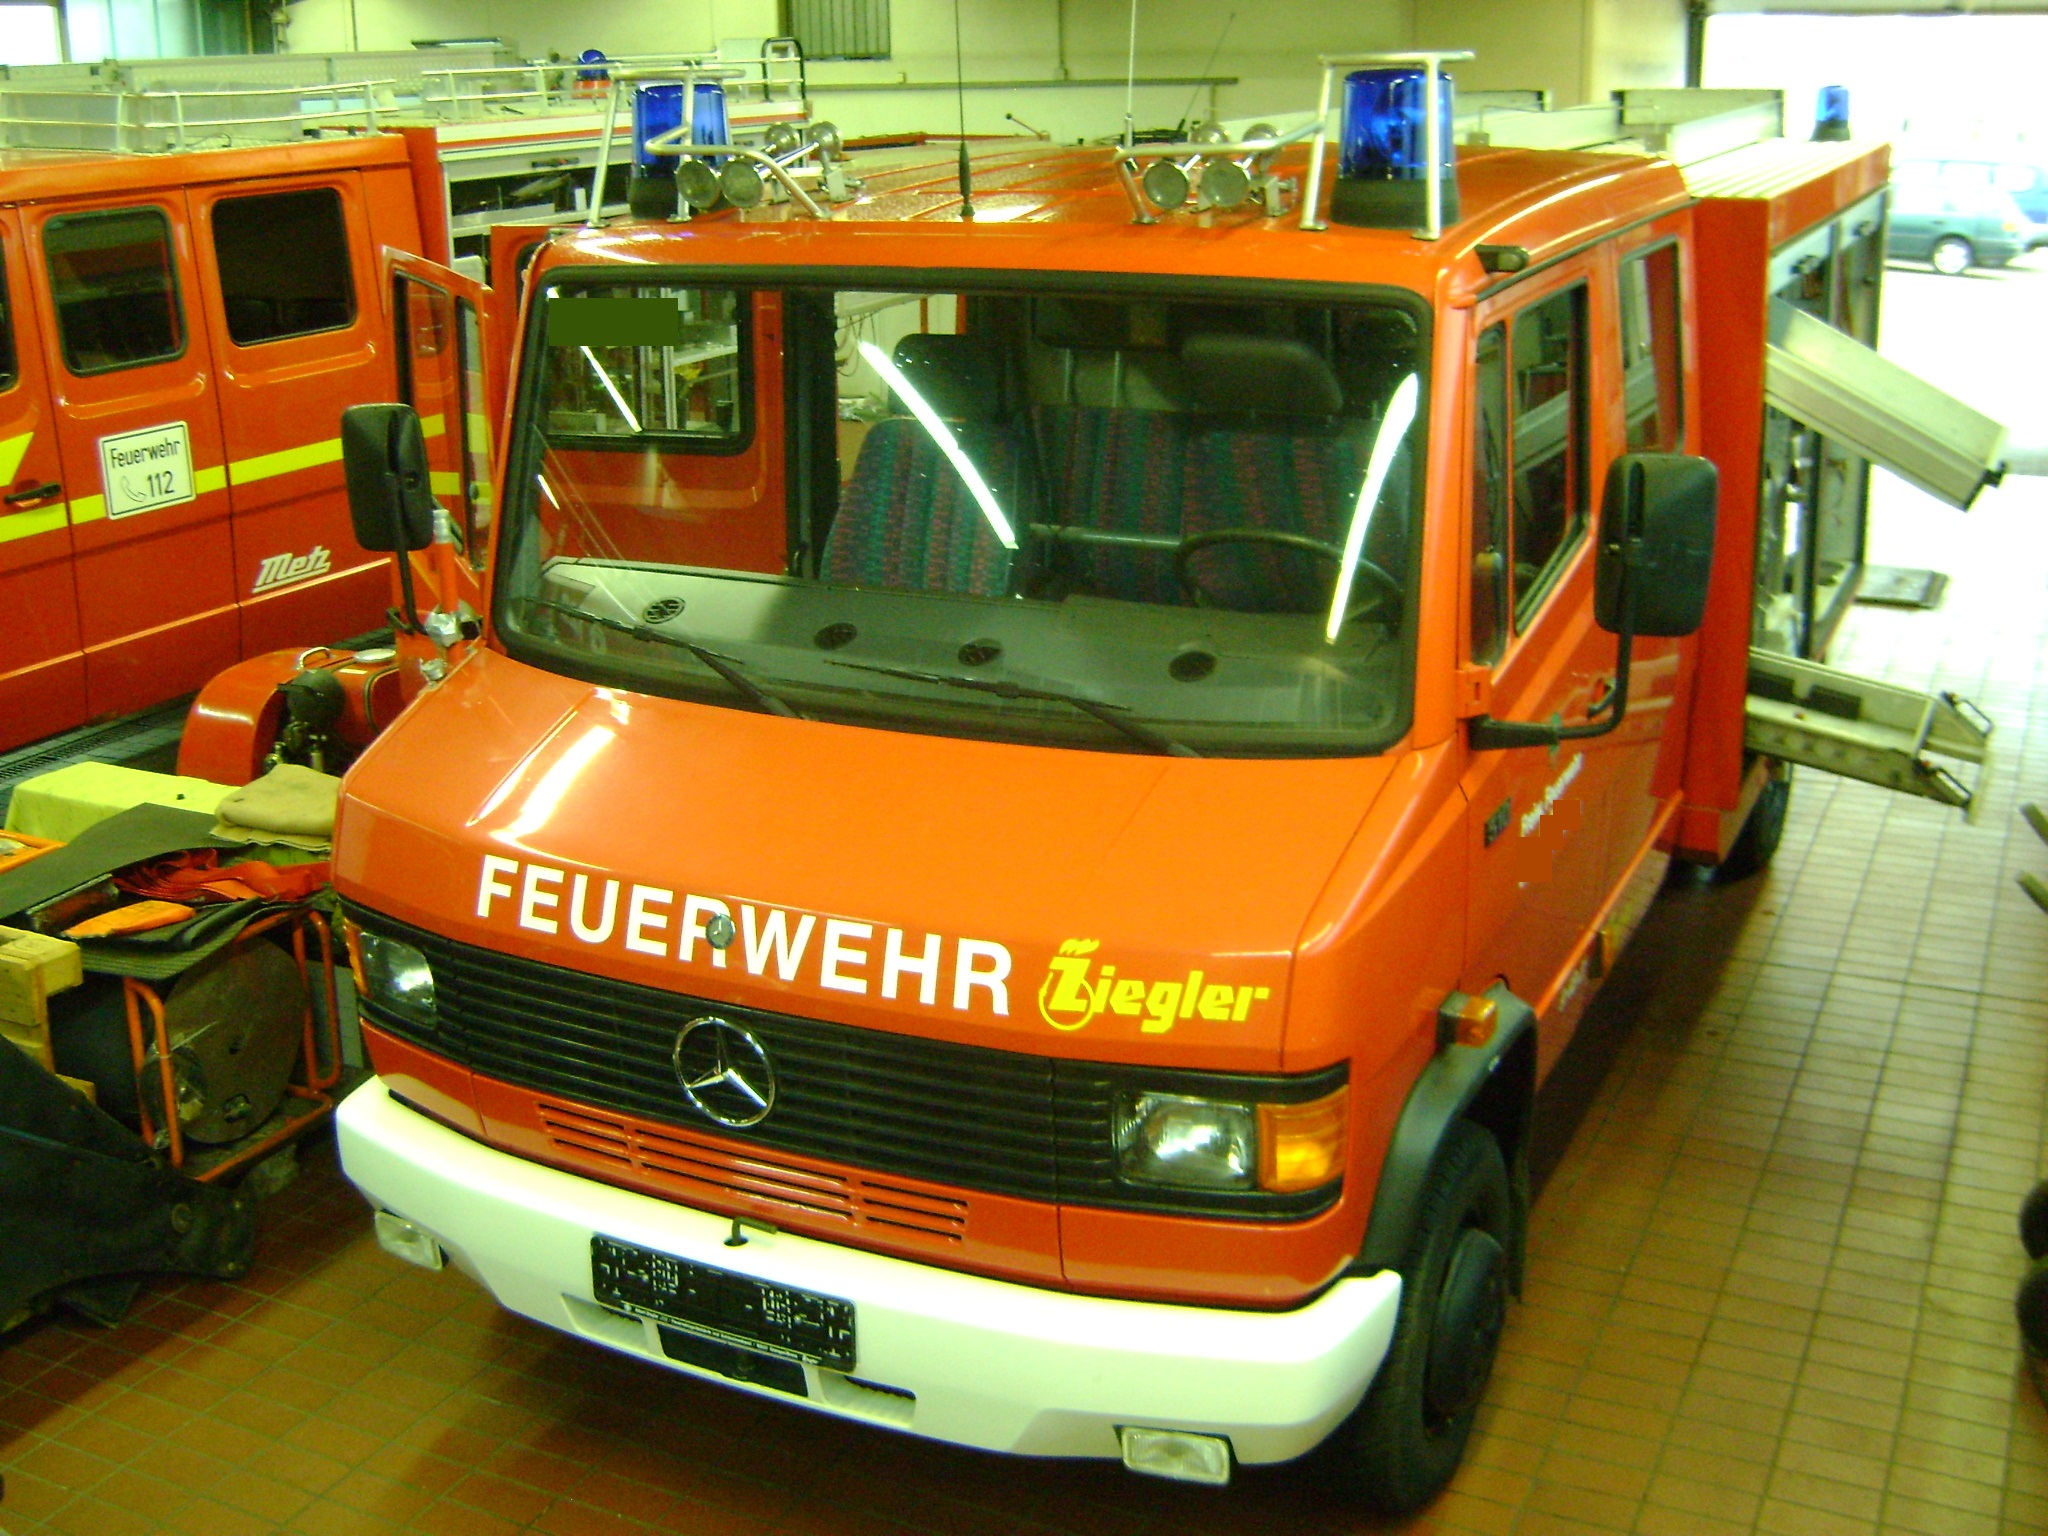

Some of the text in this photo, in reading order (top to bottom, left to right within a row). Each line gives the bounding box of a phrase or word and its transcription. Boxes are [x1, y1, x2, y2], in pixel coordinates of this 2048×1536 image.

[110, 437, 181, 469] Feuerwehr
[147, 470, 175, 498] 112
[252, 545, 331, 594] Metz
[475, 853, 1014, 1017] FEUERWEHR
[1038, 938, 1270, 1034] Ziegler
